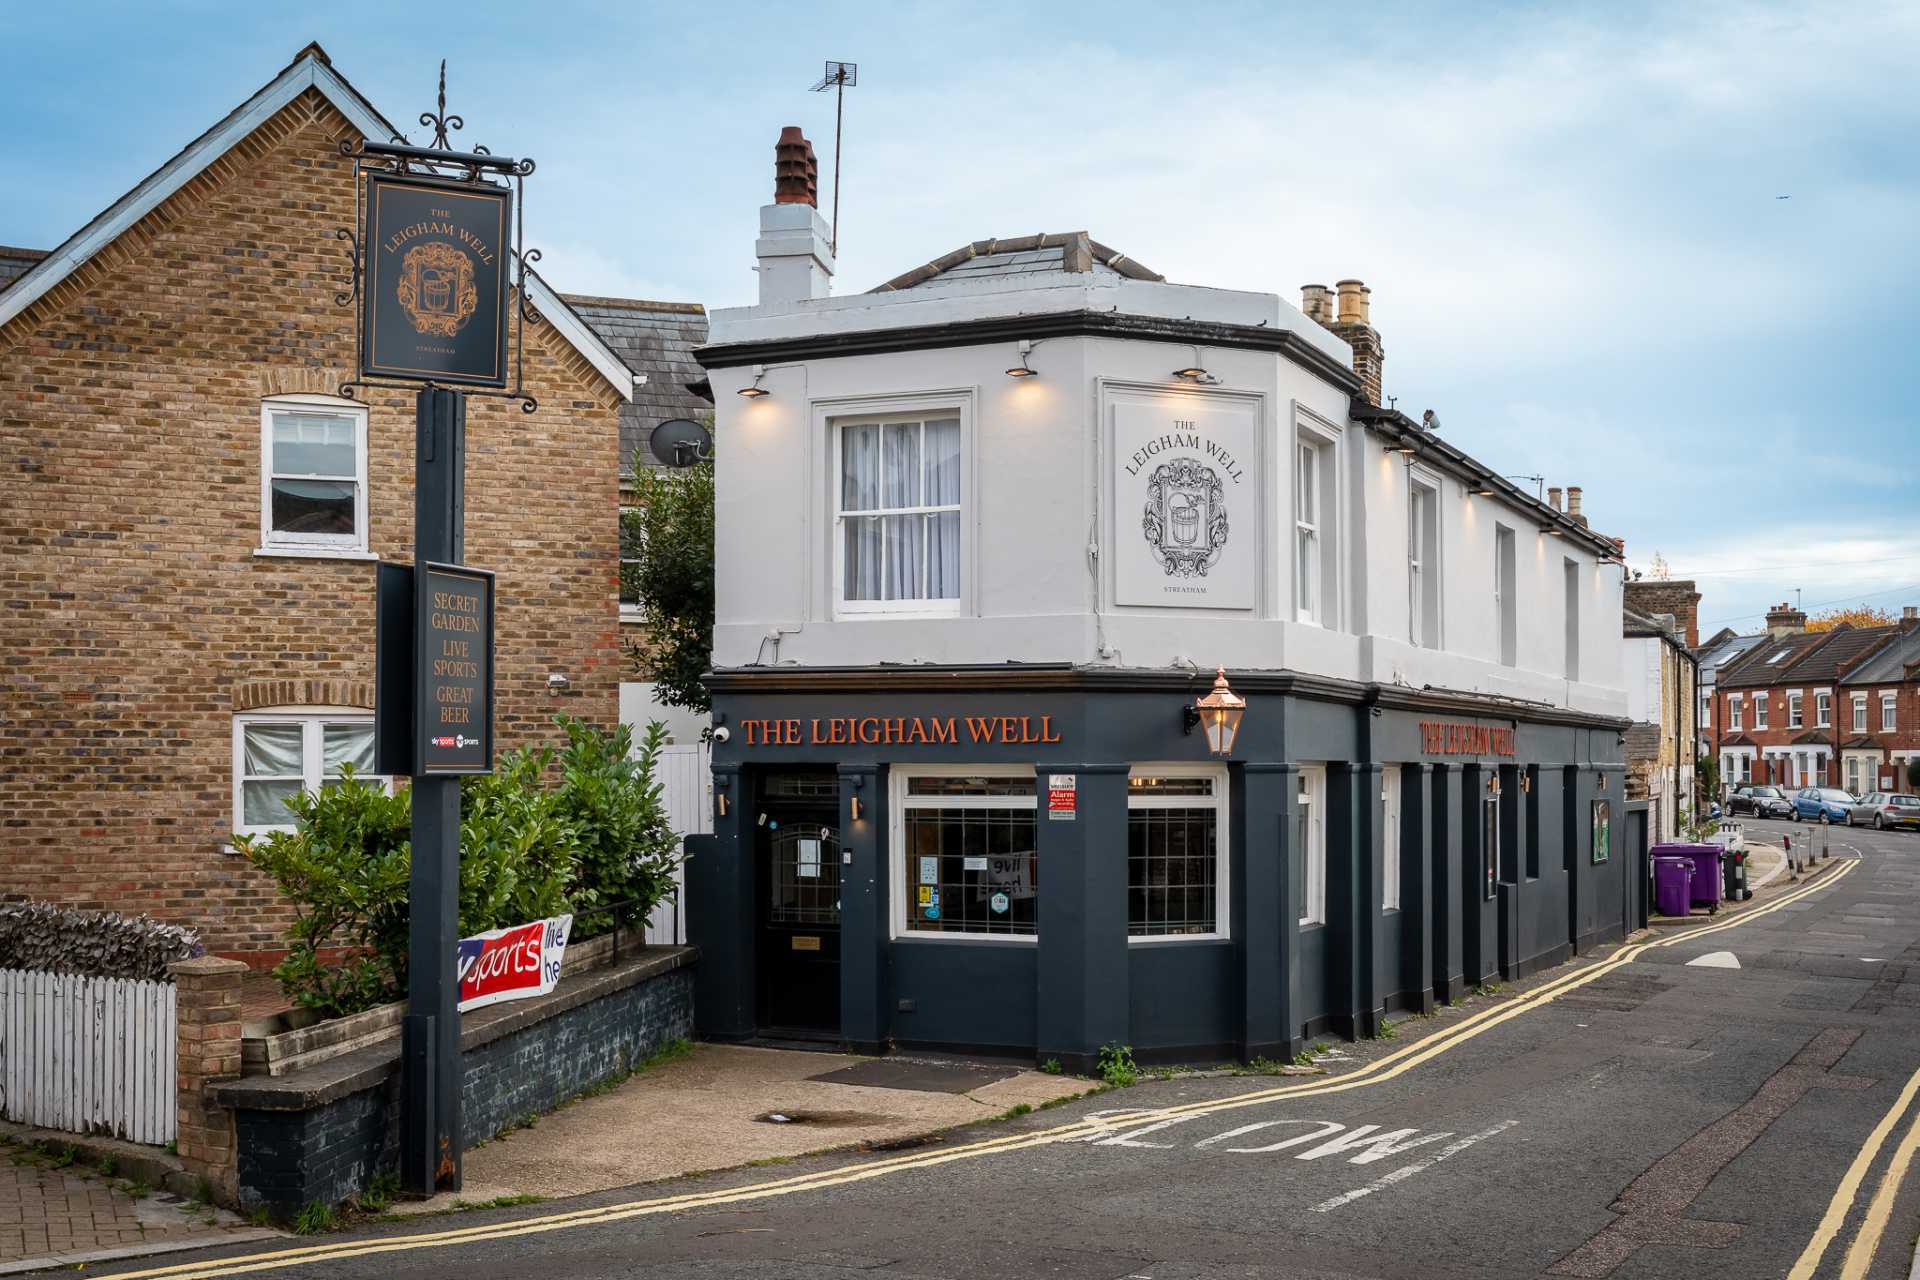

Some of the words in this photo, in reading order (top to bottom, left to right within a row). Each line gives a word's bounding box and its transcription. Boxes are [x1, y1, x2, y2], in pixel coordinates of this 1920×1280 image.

[431, 208, 450, 218] THE
[384, 221, 454, 254] LEIGHAM
[459, 228, 496, 266] WELL
[1173, 420, 1196, 430] THE
[1125, 433, 1200, 477] LEIGHAM
[1205, 439, 1243, 484] WELL
[1164, 586, 1207, 594] STREATHAM
[434, 591, 479, 613] SECRET
[431, 612, 480, 633] GARDEN
[443, 639, 469, 657] LIVE
[433, 660, 478, 679] SPORTS
[436, 685, 474, 704] GREAT
[440, 706, 470, 724] BEER
[740, 718, 801, 745] THE
[810, 716, 959, 745] LEIGHAM
[965, 715, 1061, 745] WELL
[1050, 790, 1075, 798] Alarm
[545, 921, 564, 949] live
[467, 936, 540, 991] sports
